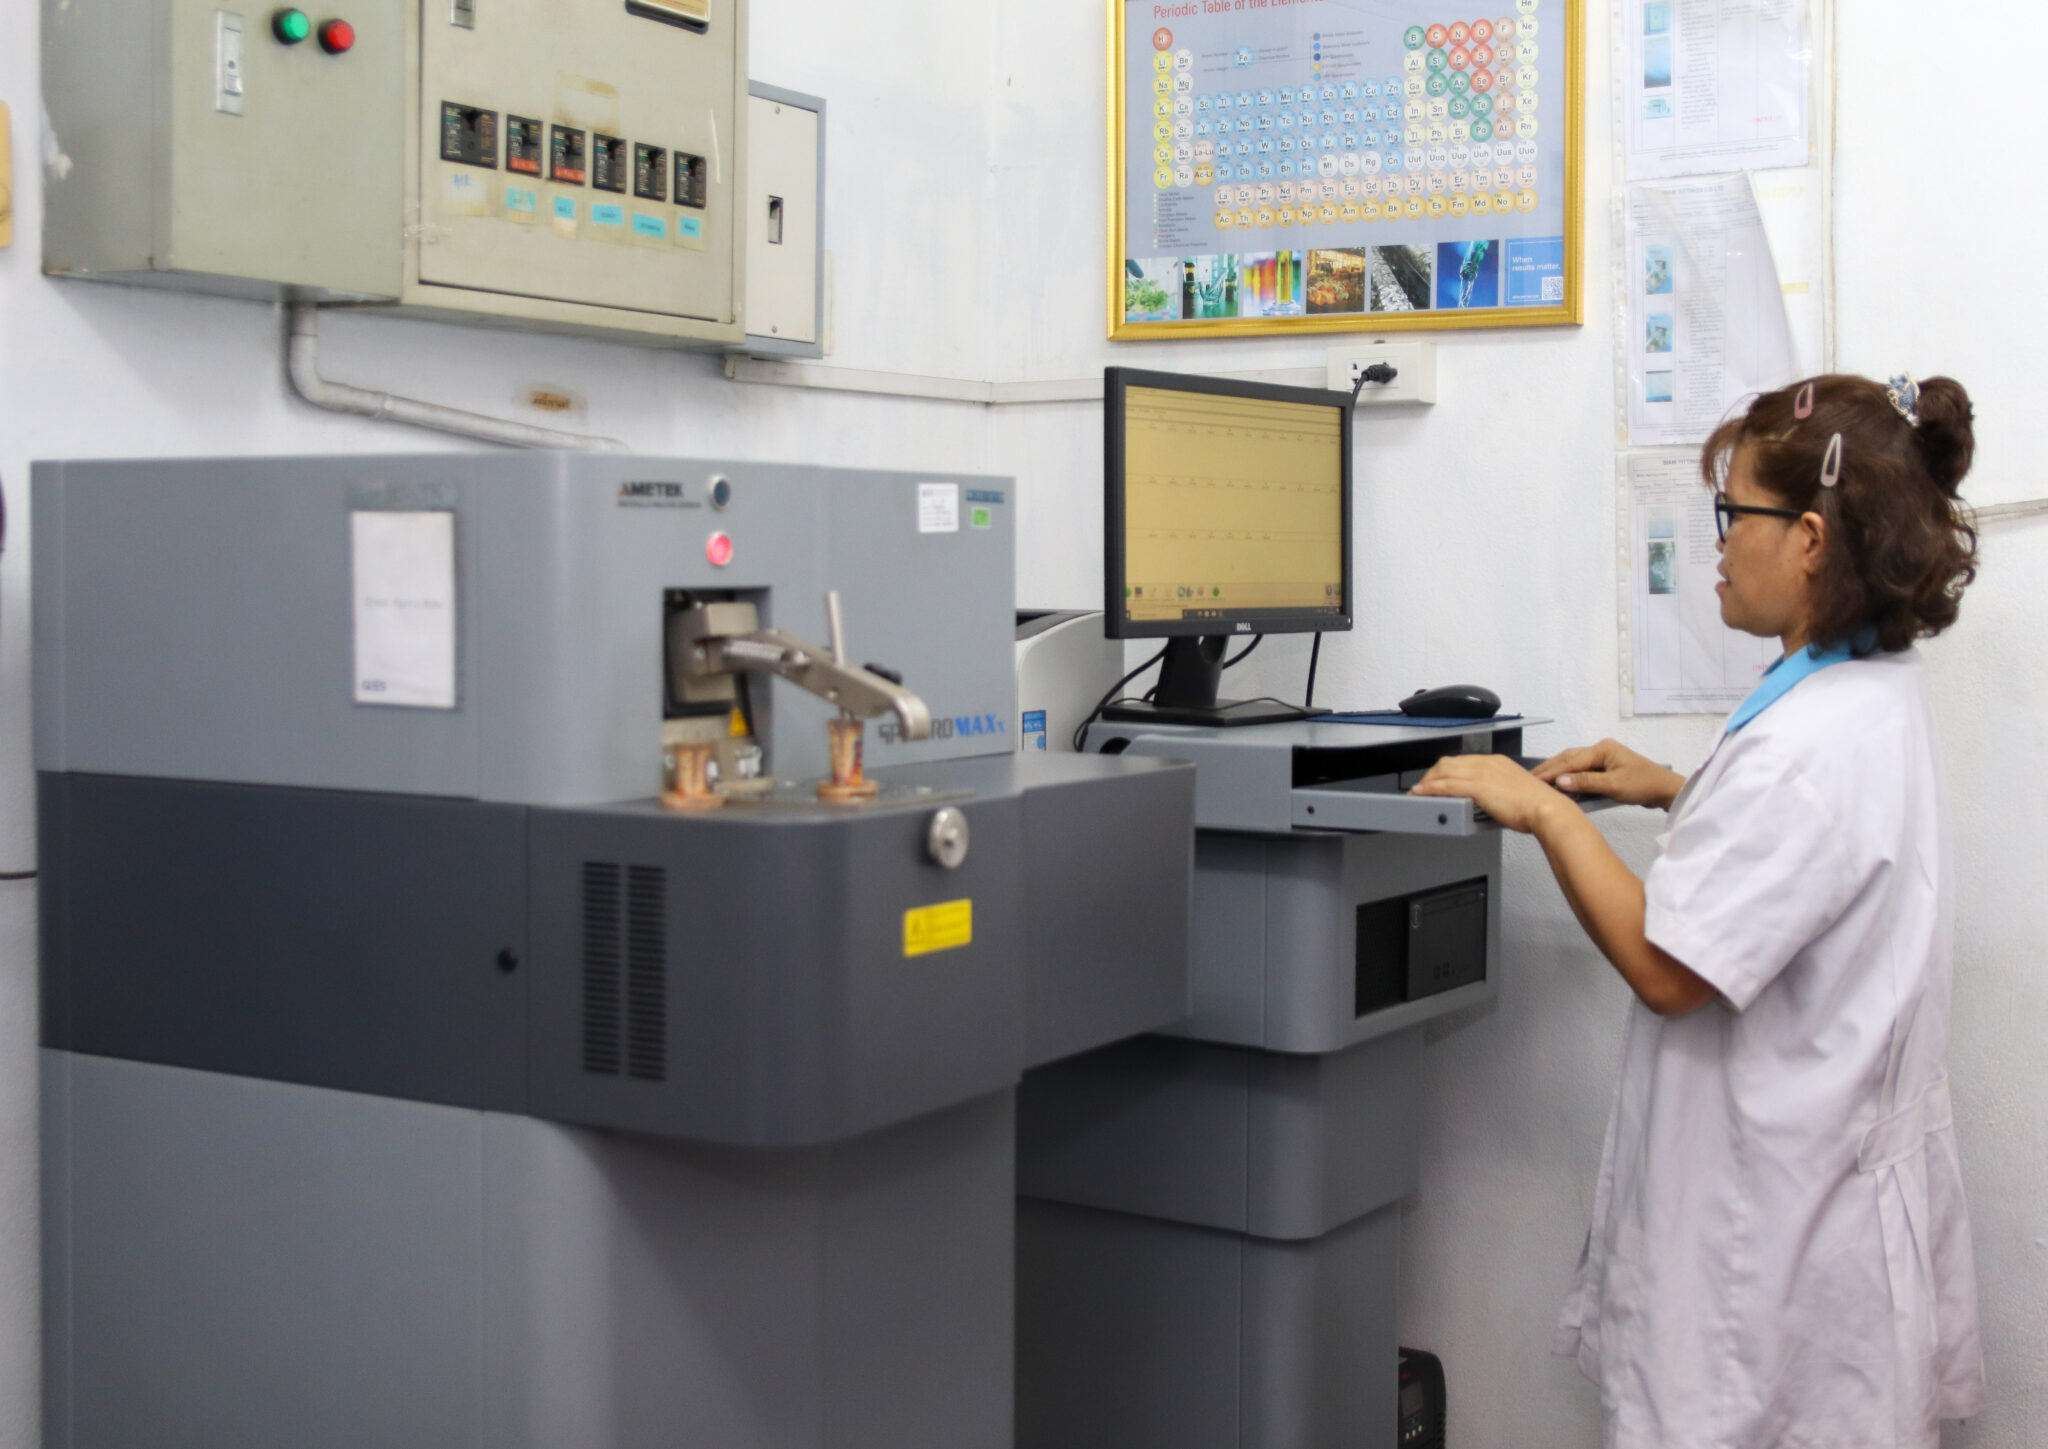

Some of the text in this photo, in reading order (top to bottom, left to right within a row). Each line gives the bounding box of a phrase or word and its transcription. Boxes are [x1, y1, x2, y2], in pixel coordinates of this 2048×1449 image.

[1153, 3, 1198, 19] Periodic
[1202, 0, 1231, 14] Table
[1234, 0, 1247, 10] of
[1178, 80, 1190, 89] Mg
[1366, 112, 1376, 120] Ag
[1388, 134, 1398, 142] Hg
[1260, 166, 1270, 174] Sg
[1366, 158, 1376, 167] Rg
[1452, 152, 1467, 161] Uup
[618, 481, 684, 498] AMETEK
[1236, 622, 1251, 632] DELL
[878, 713, 1005, 744] SPROMAXx
